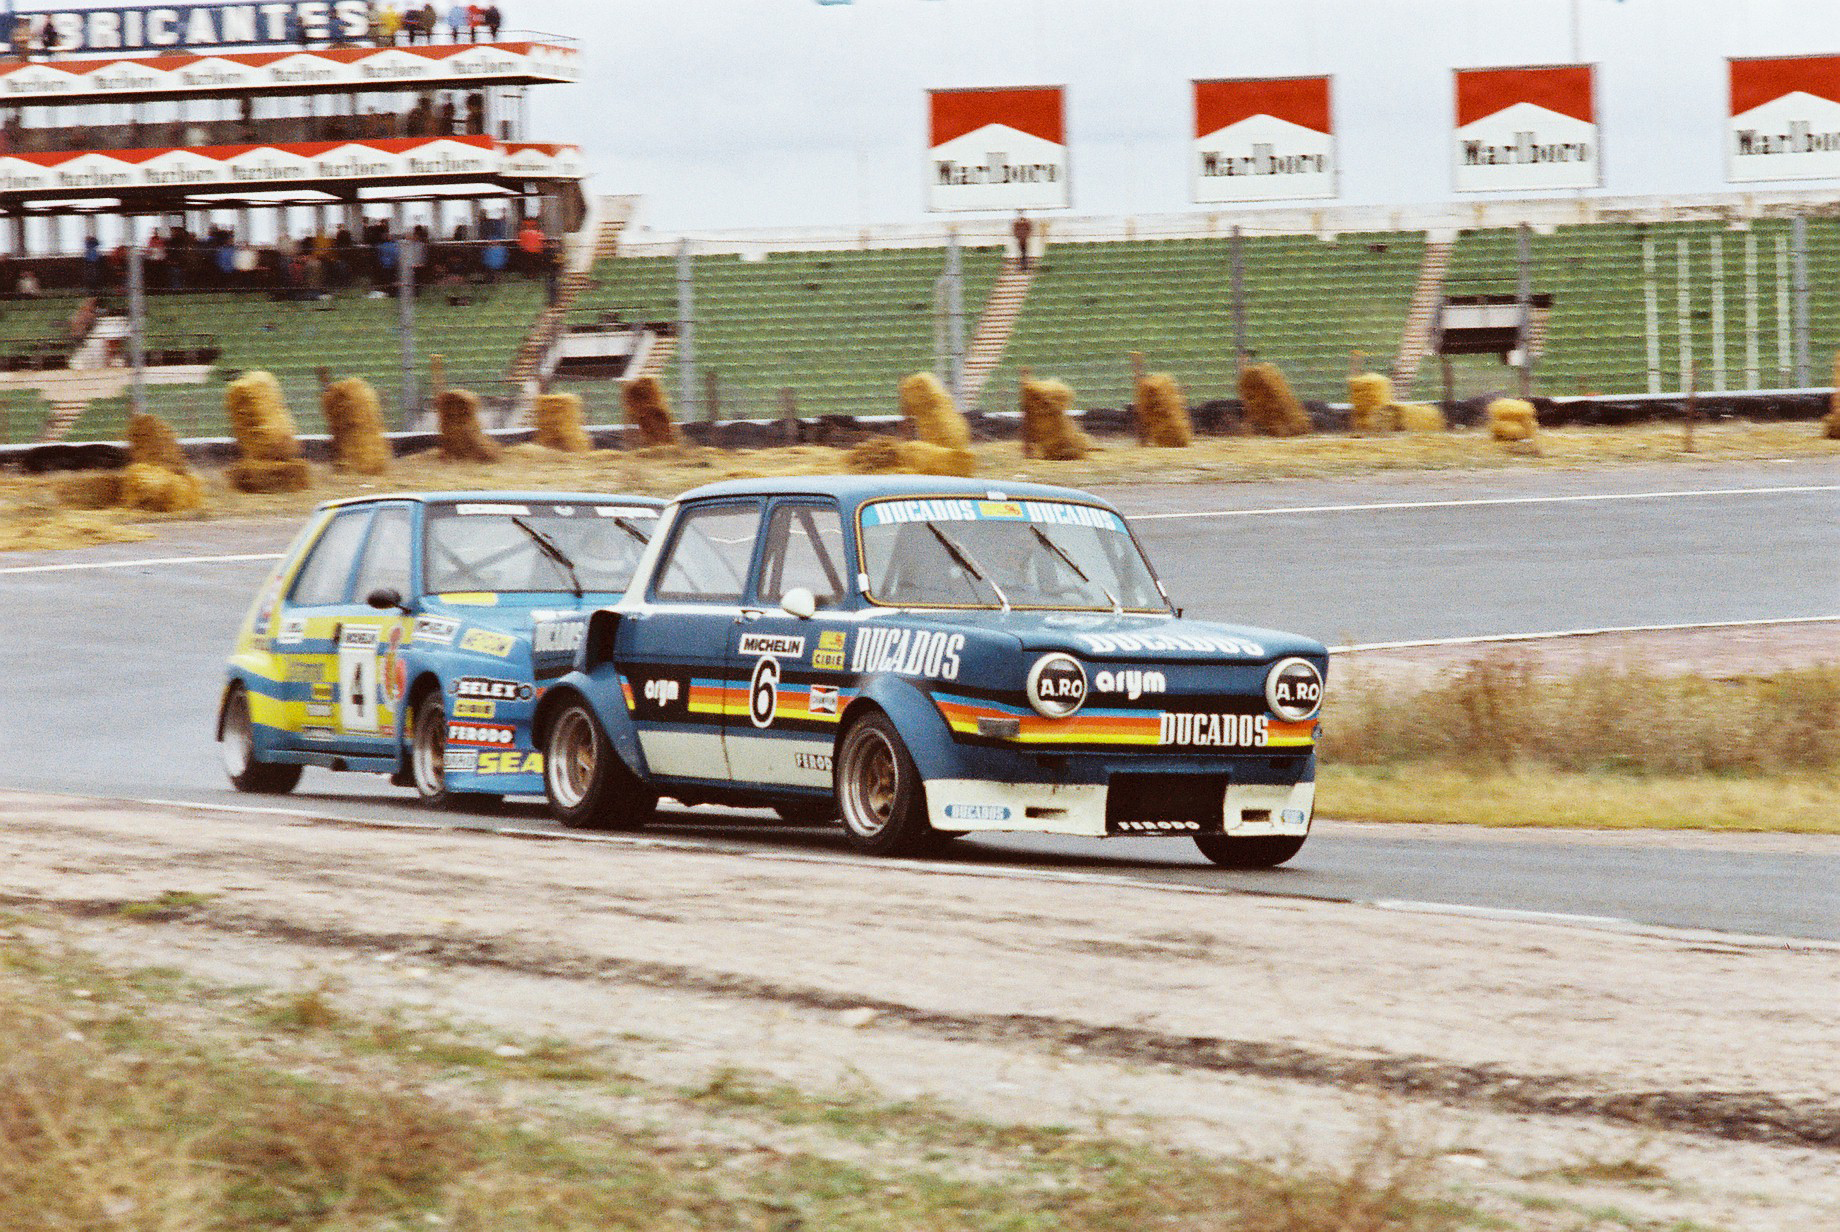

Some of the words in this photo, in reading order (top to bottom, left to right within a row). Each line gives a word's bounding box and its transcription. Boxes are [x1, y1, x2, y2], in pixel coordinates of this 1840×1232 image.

[874, 500, 977, 524] DUCADOS
[1025, 501, 1117, 531] DUCADOS
[742, 636, 801, 655] MICHELIN
[851, 627, 966, 681] DUCADOS
[1076, 632, 1266, 656] DUCADOS
[751, 659, 780, 726] 6
[1095, 669, 1168, 700] arym
[1158, 712, 1270, 748] DUCADOS
